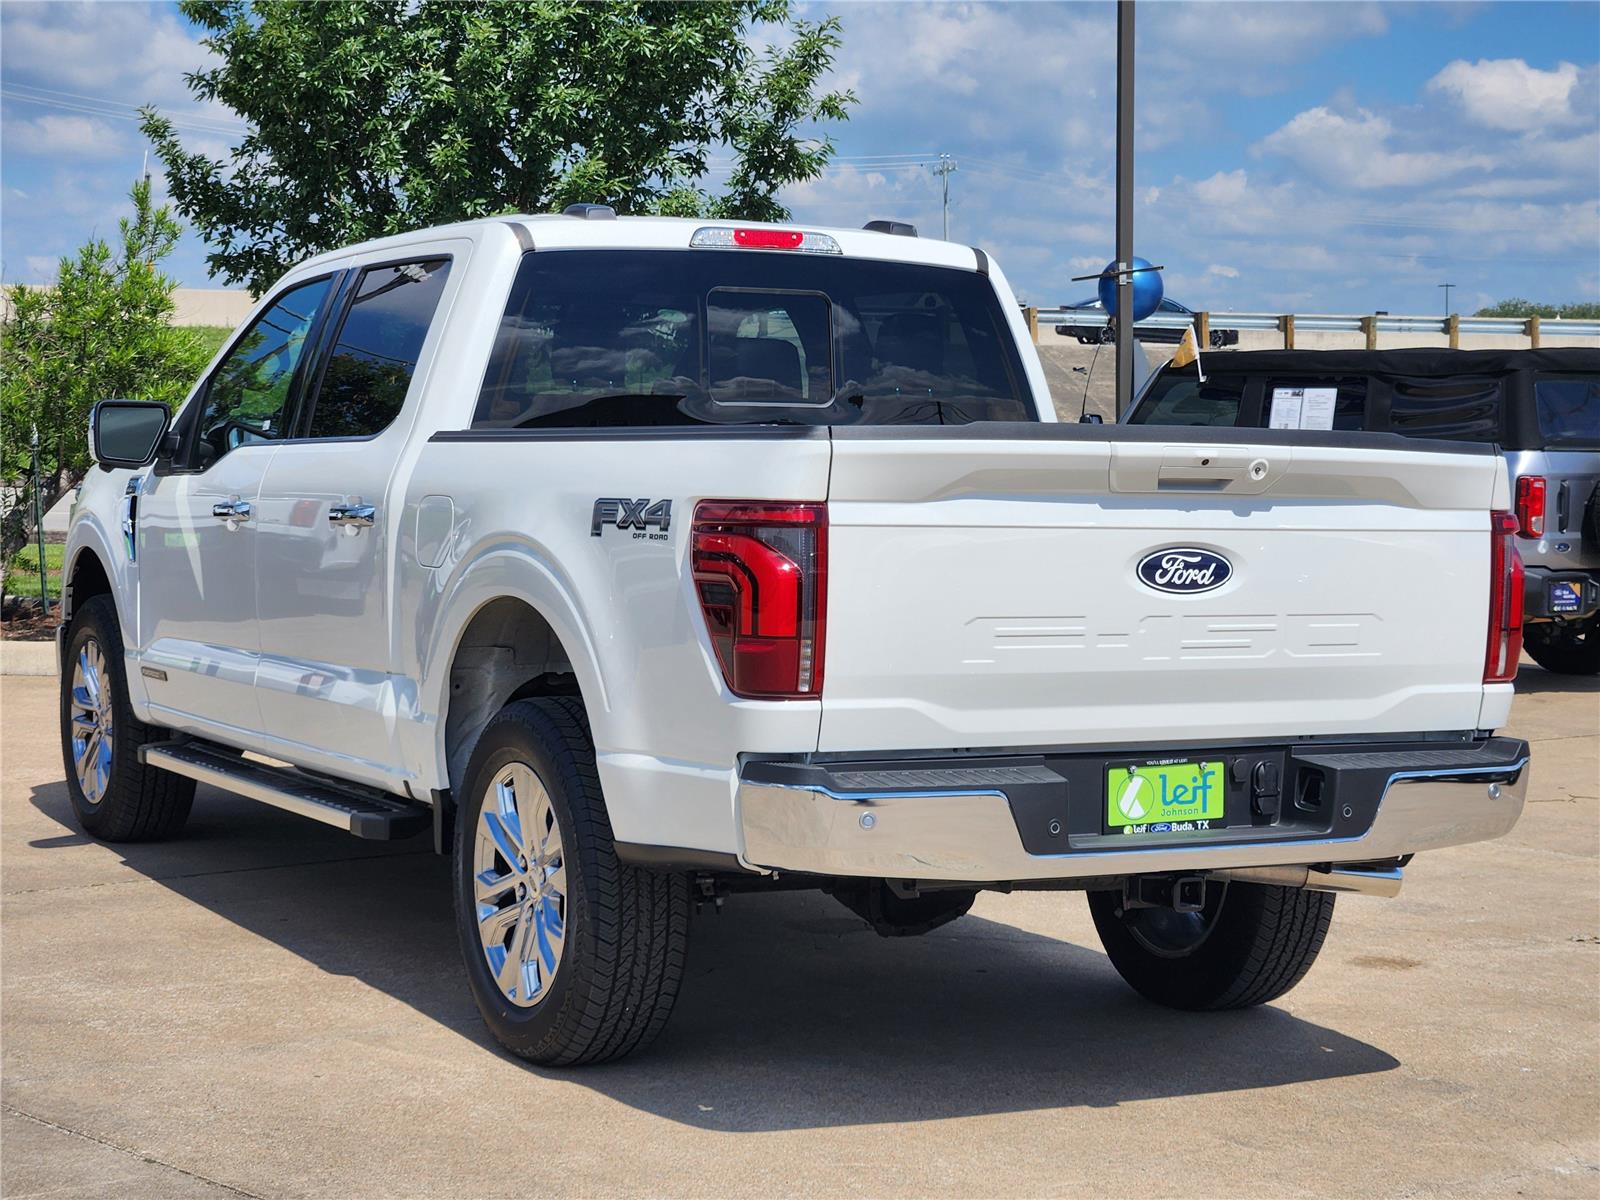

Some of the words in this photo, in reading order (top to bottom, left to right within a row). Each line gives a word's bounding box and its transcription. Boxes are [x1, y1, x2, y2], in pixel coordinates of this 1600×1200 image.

[591, 498, 672, 537] FX4
[632, 532, 646, 540] OFF
[649, 532, 668, 541] ROAD
[1155, 554, 1217, 585] Ford
[1159, 771, 1215, 813] leif
[1160, 808, 1199, 817] Johnson
[1171, 821, 1195, 832] Buda,
[1196, 820, 1210, 830] TX
